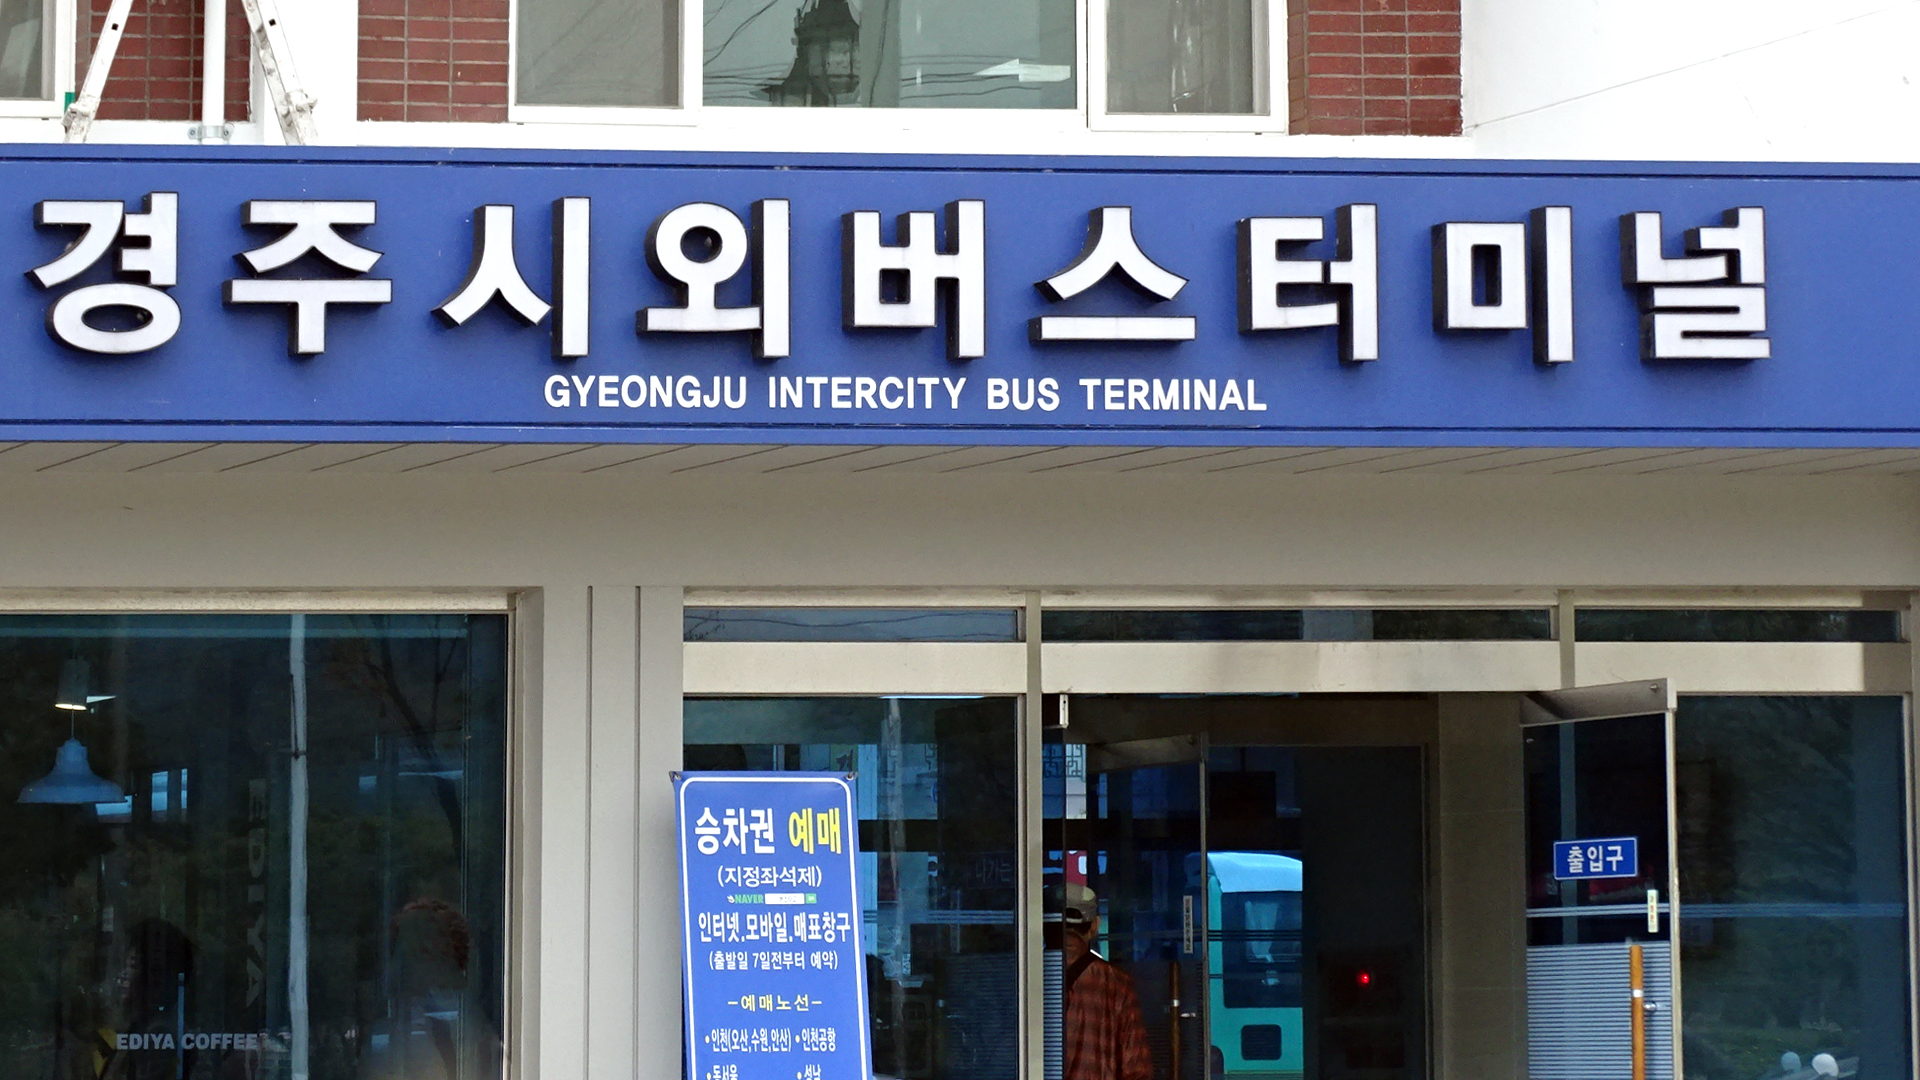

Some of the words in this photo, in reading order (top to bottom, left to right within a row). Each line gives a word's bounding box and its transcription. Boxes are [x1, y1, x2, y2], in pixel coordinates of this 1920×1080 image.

[544, 374, 747, 410] GYEONGJU
[768, 376, 967, 411] INTERCITY
[987, 378, 1060, 412] BUS
[1079, 378, 1268, 412] TERMINAL
[694, 806, 776, 856] 승차권
[788, 807, 842, 855] 예매
[1566, 845, 1624, 873] 출입구
[717, 865, 823, 888] (지정좌석제)
[734, 893, 764, 904] NAVER
[708, 950, 749, 971] (출발일
[752, 951, 805, 971] 7일전부터
[810, 950, 839, 971] 예약)
[115, 1033, 175, 1051] EDIYA
[180, 1033, 259, 1051] COFFEE
[801, 1027, 837, 1053] 인천공항
